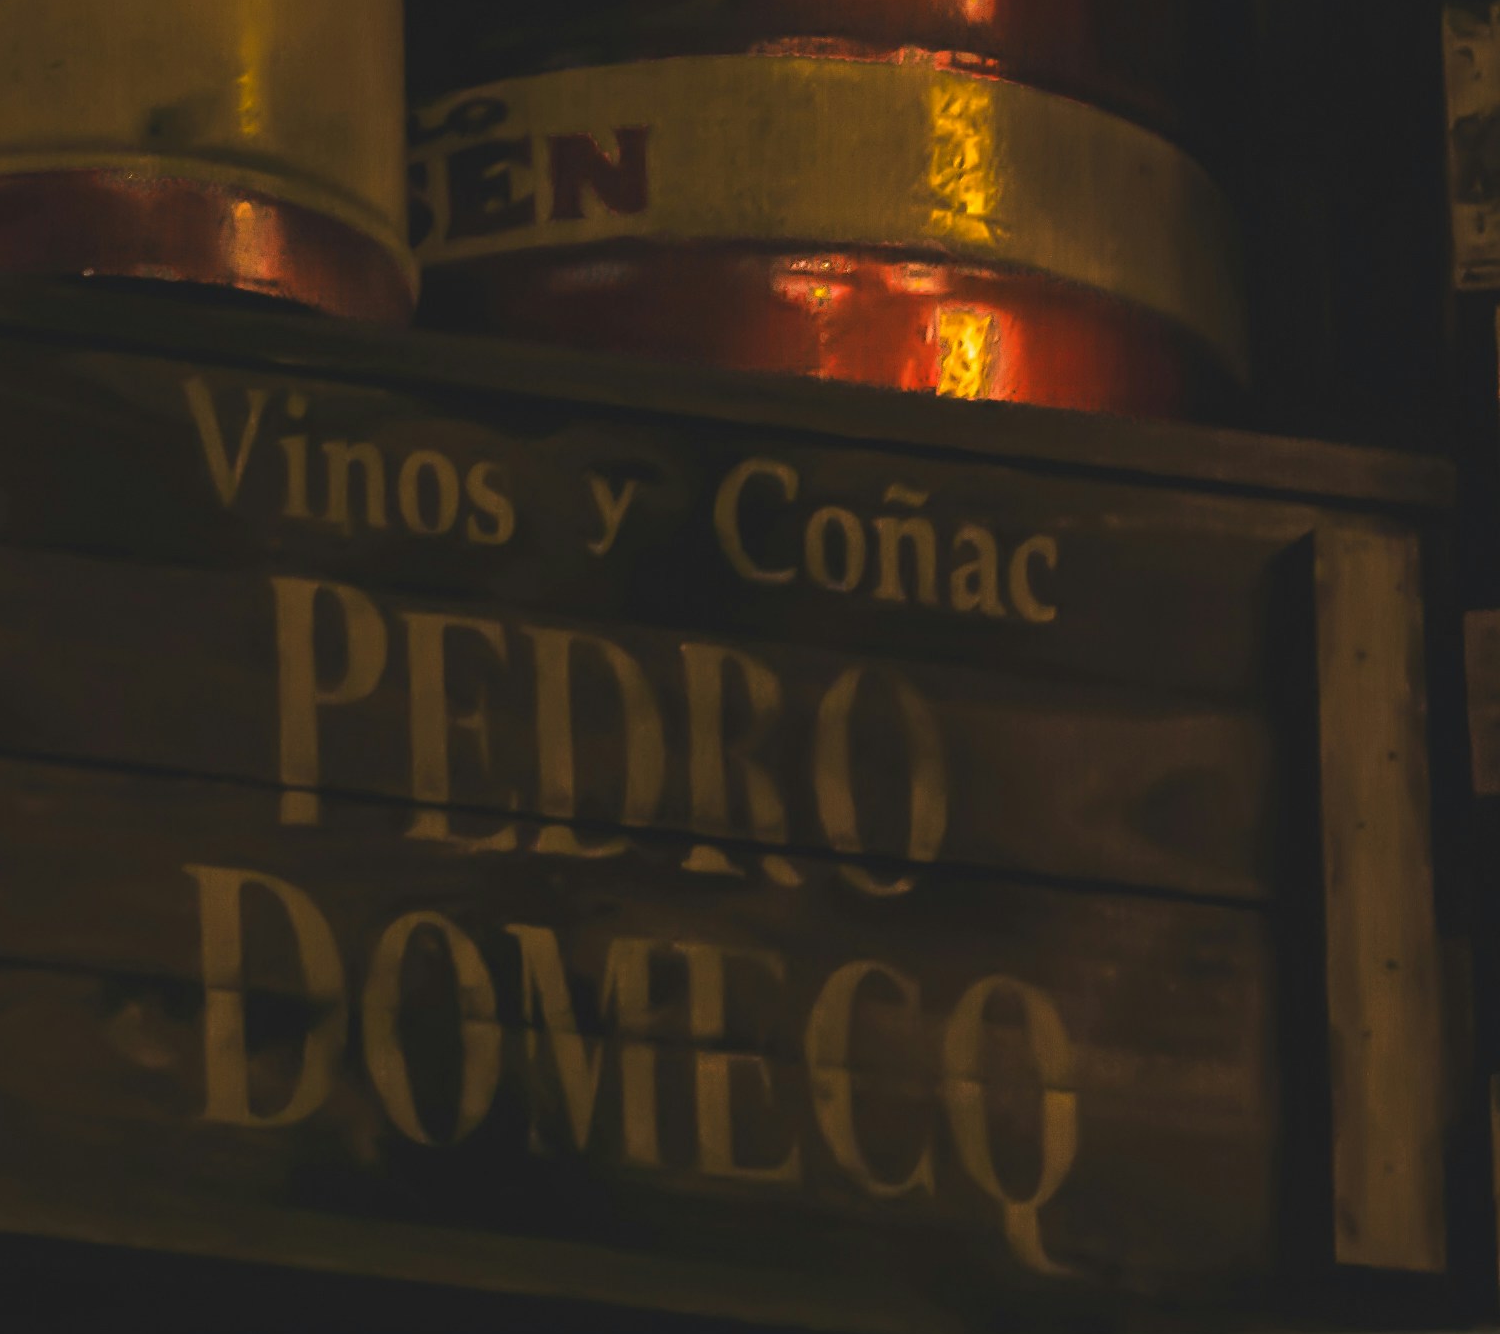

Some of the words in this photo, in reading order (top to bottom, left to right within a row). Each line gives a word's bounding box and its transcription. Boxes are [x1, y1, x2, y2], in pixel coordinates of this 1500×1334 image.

[182, 375, 517, 547] Vinos
[587, 470, 641, 557] y
[713, 457, 1060, 623] Coñac
[269, 574, 950, 897] PEDRO
[182, 863, 1087, 1277] DOMECQ
